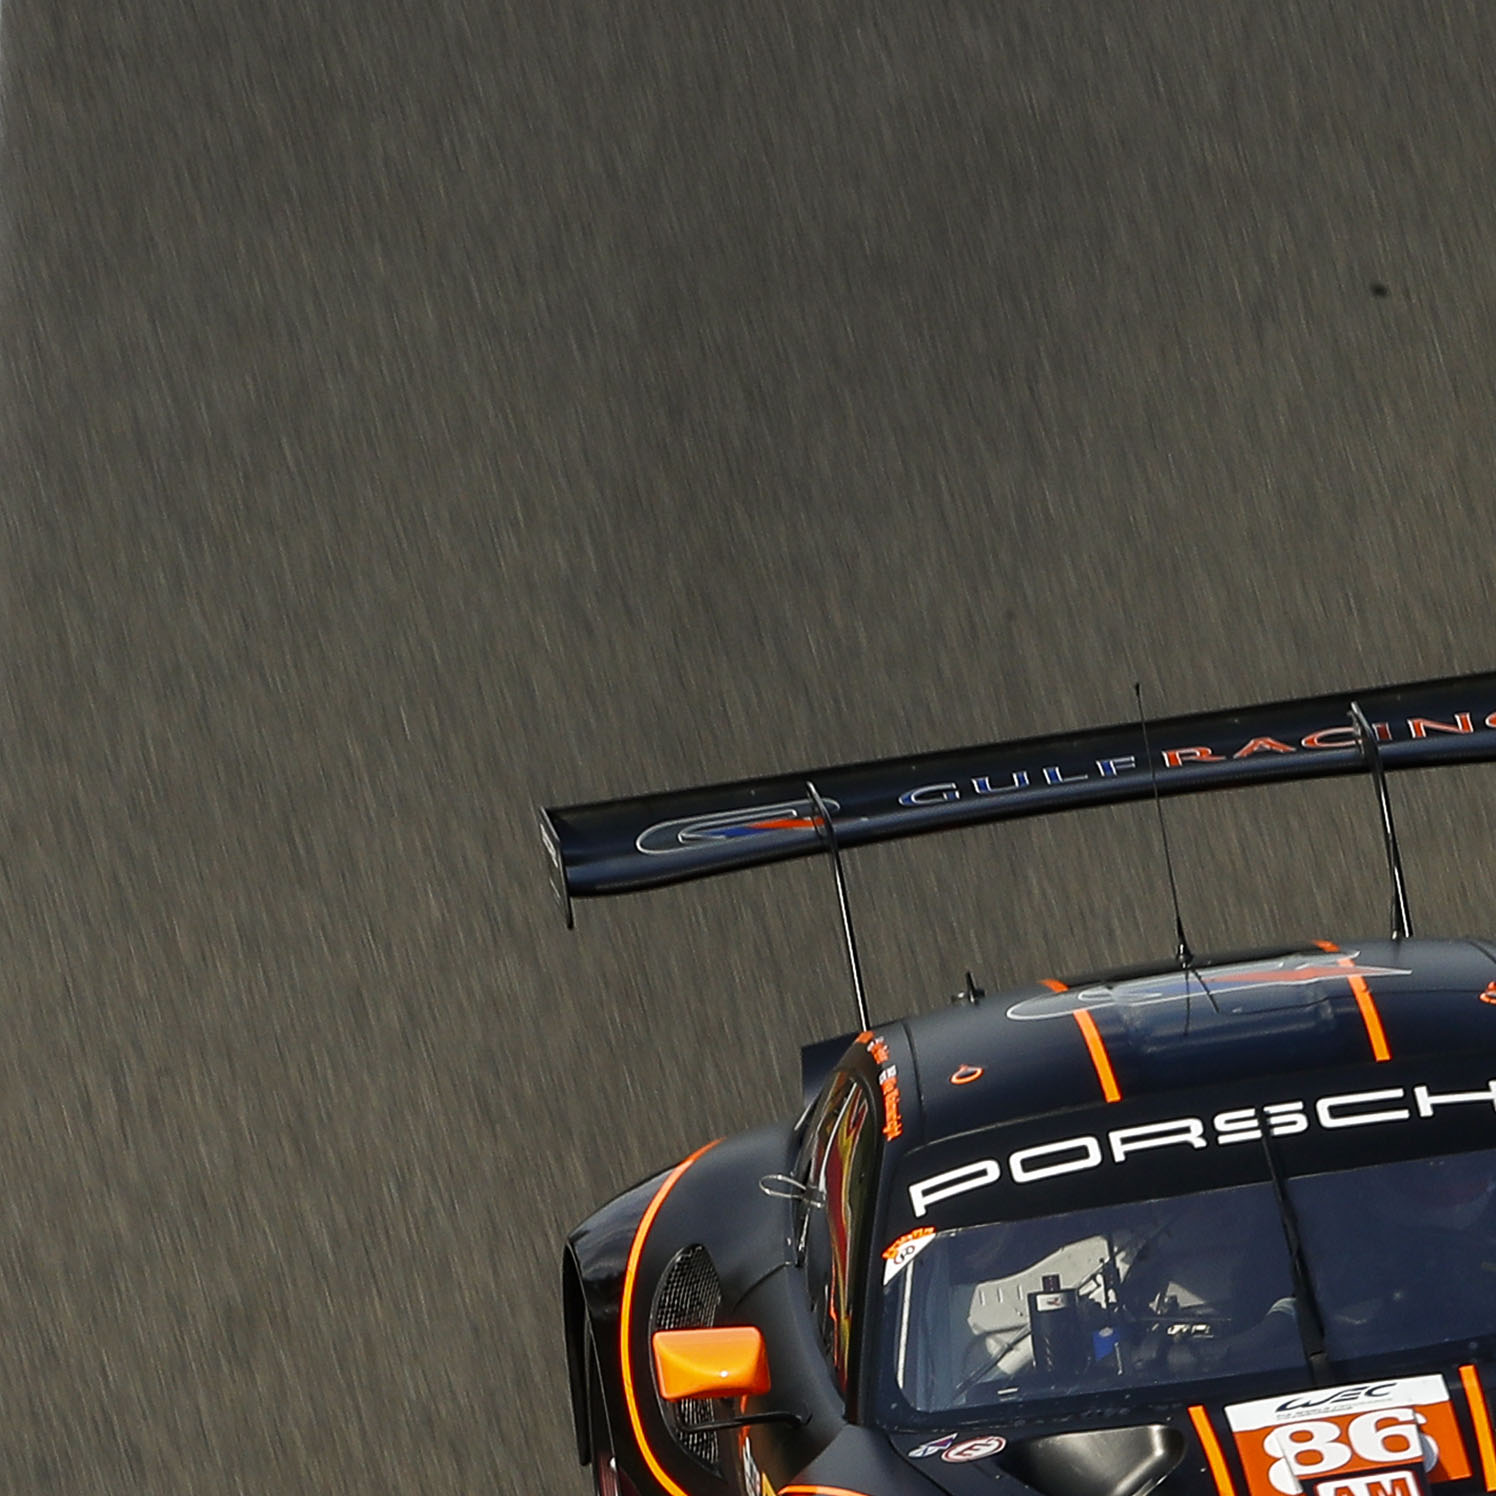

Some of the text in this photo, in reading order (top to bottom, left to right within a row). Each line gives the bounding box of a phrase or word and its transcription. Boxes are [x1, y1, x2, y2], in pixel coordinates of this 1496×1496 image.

[898, 755, 1137, 806] GULF
[1275, 1382, 1398, 1412] WEC
[1263, 1407, 1439, 1496] 86
